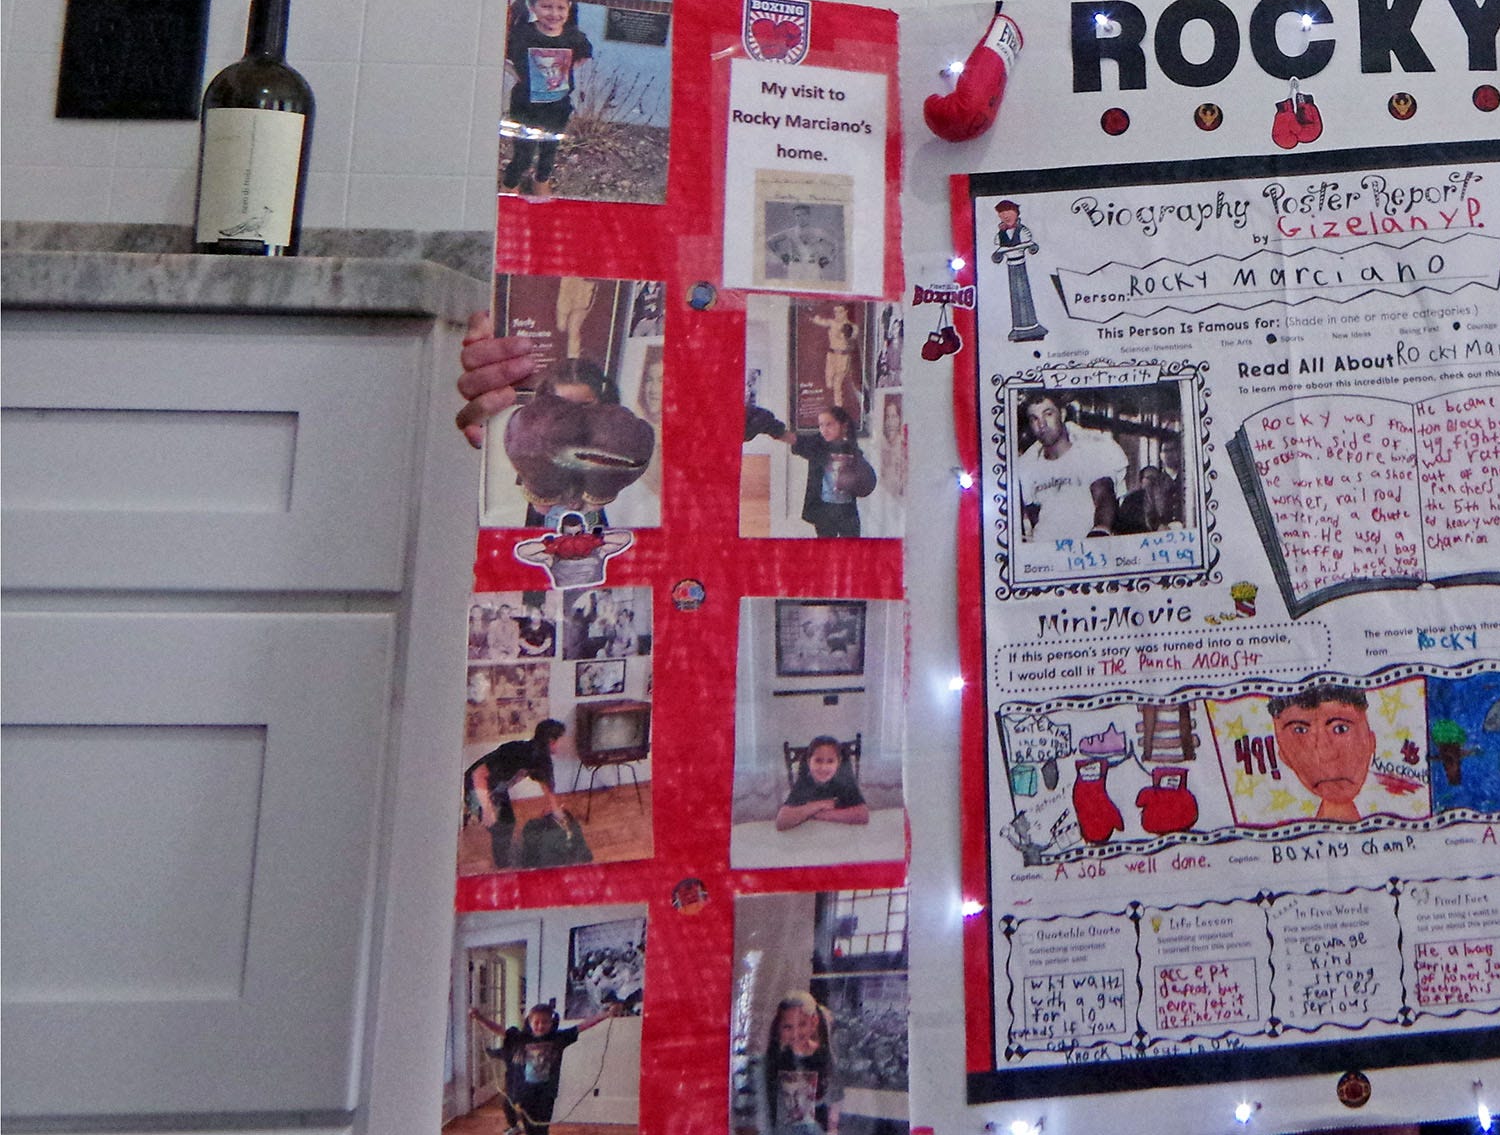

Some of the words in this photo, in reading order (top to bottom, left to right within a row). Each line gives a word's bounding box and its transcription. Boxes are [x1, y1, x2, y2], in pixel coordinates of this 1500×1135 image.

[752, 0, 804, 15] BOXING
[761, 81, 787, 99] My
[790, 83, 825, 100] visit
[829, 87, 845, 102] to
[733, 109, 780, 130] Rocky
[785, 113, 872, 134] Marciano's
[777, 144, 828, 161] home.
[1071, 191, 1250, 237] Biography
[1262, 182, 1361, 215] Poster
[1360, 170, 1484, 215] Report
[1253, 234, 1269, 245] by
[912, 284, 973, 307] BOXING
[1075, 293, 1131, 304] Person:
[1098, 327, 1123, 339] This
[1129, 326, 1174, 337] Person
[1180, 323, 1192, 333] Is
[1199, 321, 1249, 332] Famous
[1255, 318, 1280, 328] for:
[1285, 317, 1324, 328] (Shade
[1327, 315, 1337, 324] in
[1341, 315, 1360, 324] one
[1365, 313, 1375, 322] or
[1381, 311, 1408, 321] more
[1238, 359, 1289, 378] Read
[1299, 357, 1323, 374] All
[1334, 353, 1393, 371] About
[1051, 368, 1150, 386] Portrait
[1252, 384, 1275, 393] learn
[1279, 383, 1302, 391] more
[1306, 380, 1332, 389] about
[1336, 379, 1351, 387] this
[1354, 376, 1399, 386] incredible
[1440, 371, 1464, 380] check
[1485, 369, 1500, 377] this
[1416, 402, 1436, 416] He
[1418, 424, 1440, 435] ton
[1256, 440, 1275, 451] the
[1422, 472, 1446, 482] out
[1425, 500, 1444, 510] the
[1024, 564, 1054, 573] Born:
[1116, 556, 1141, 566] Died:
[1038, 599, 1192, 638] Mini-Movie
[1364, 630, 1380, 638] The
[1384, 627, 1413, 637] movie
[1416, 625, 1446, 635] below
[1450, 624, 1477, 632] shows
[1009, 653, 1018, 663] If
[1022, 652, 1043, 662] this
[1047, 646, 1097, 664] person's
[1101, 645, 1130, 658] story
[1136, 645, 1159, 653] was
[1163, 639, 1202, 652] turned
[1208, 638, 1231, 648] into
[1249, 632, 1291, 646] movie,
[1366, 648, 1388, 656] from
[1018, 669, 1055, 681] would
[1061, 666, 1082, 677] call
[1086, 665, 1095, 676] it
[1234, 735, 1281, 781] 49!
[1482, 826, 1496, 844] A
[1055, 865, 1068, 881] A
[1125, 859, 1156, 874] well
[1171, 853, 1210, 870] done.
[1296, 909, 1306, 918] In
[1170, 918, 1191, 930] Life
[1195, 916, 1233, 927] Lesson
